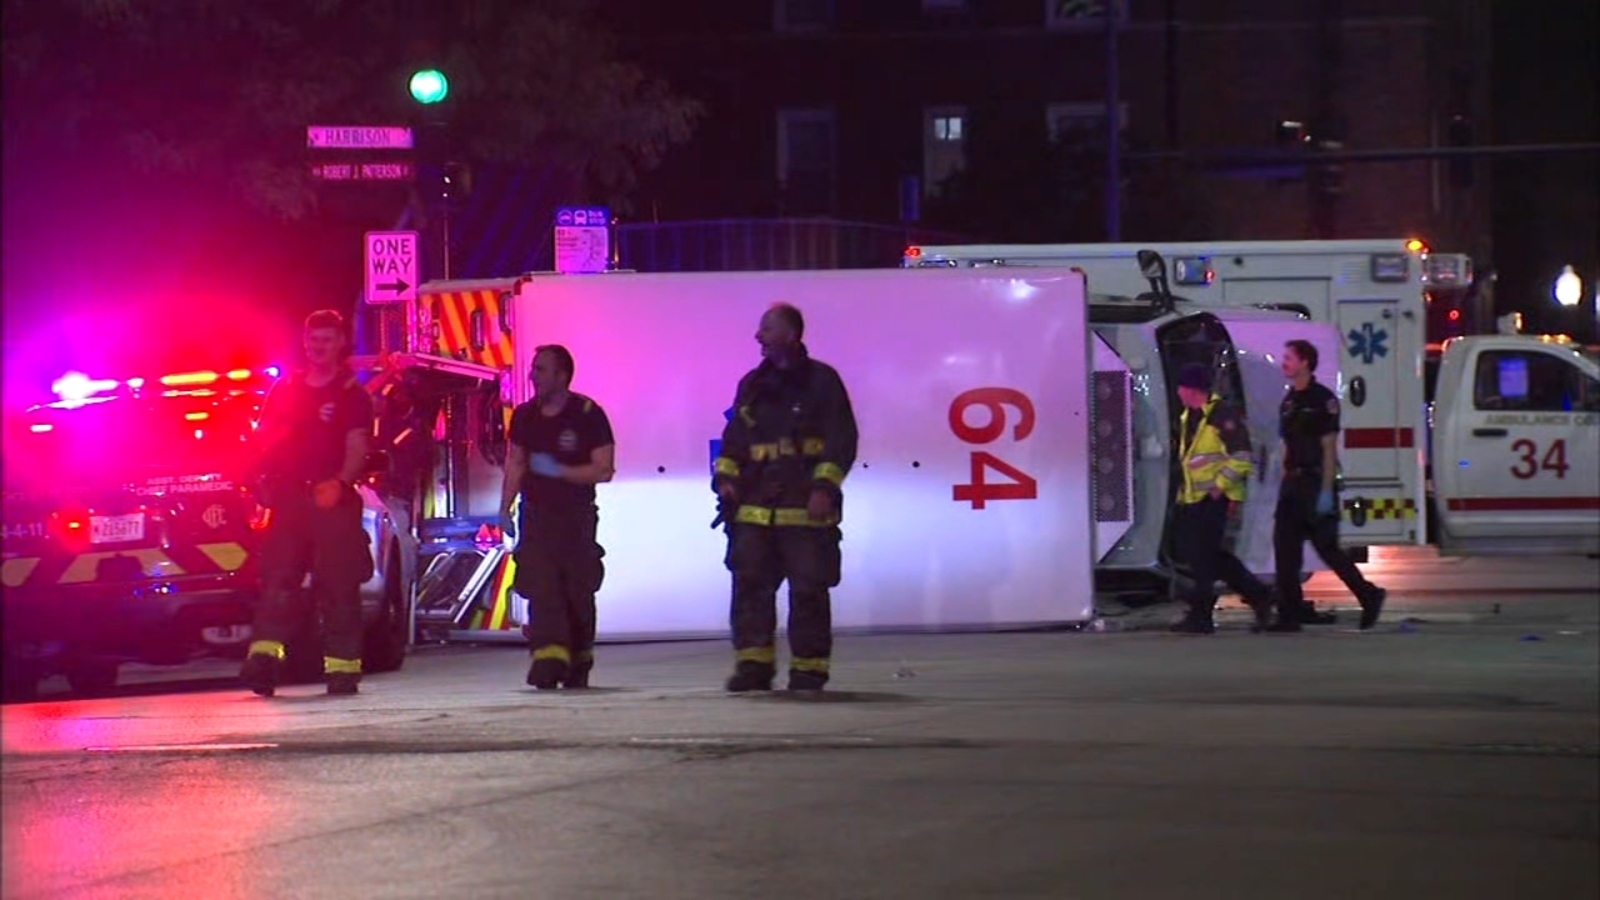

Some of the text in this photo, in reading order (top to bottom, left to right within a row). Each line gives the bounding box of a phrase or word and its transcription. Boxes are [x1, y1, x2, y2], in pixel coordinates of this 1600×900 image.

[324, 128, 391, 146] HARRISON
[372, 238, 411, 256] ONE
[372, 257, 412, 275] WAY
[1484, 413, 1571, 426] AMBULANCE
[948, 386, 1037, 510] 64
[1509, 437, 1570, 481] 34
[170, 481, 234, 493] PARAMEDIC
